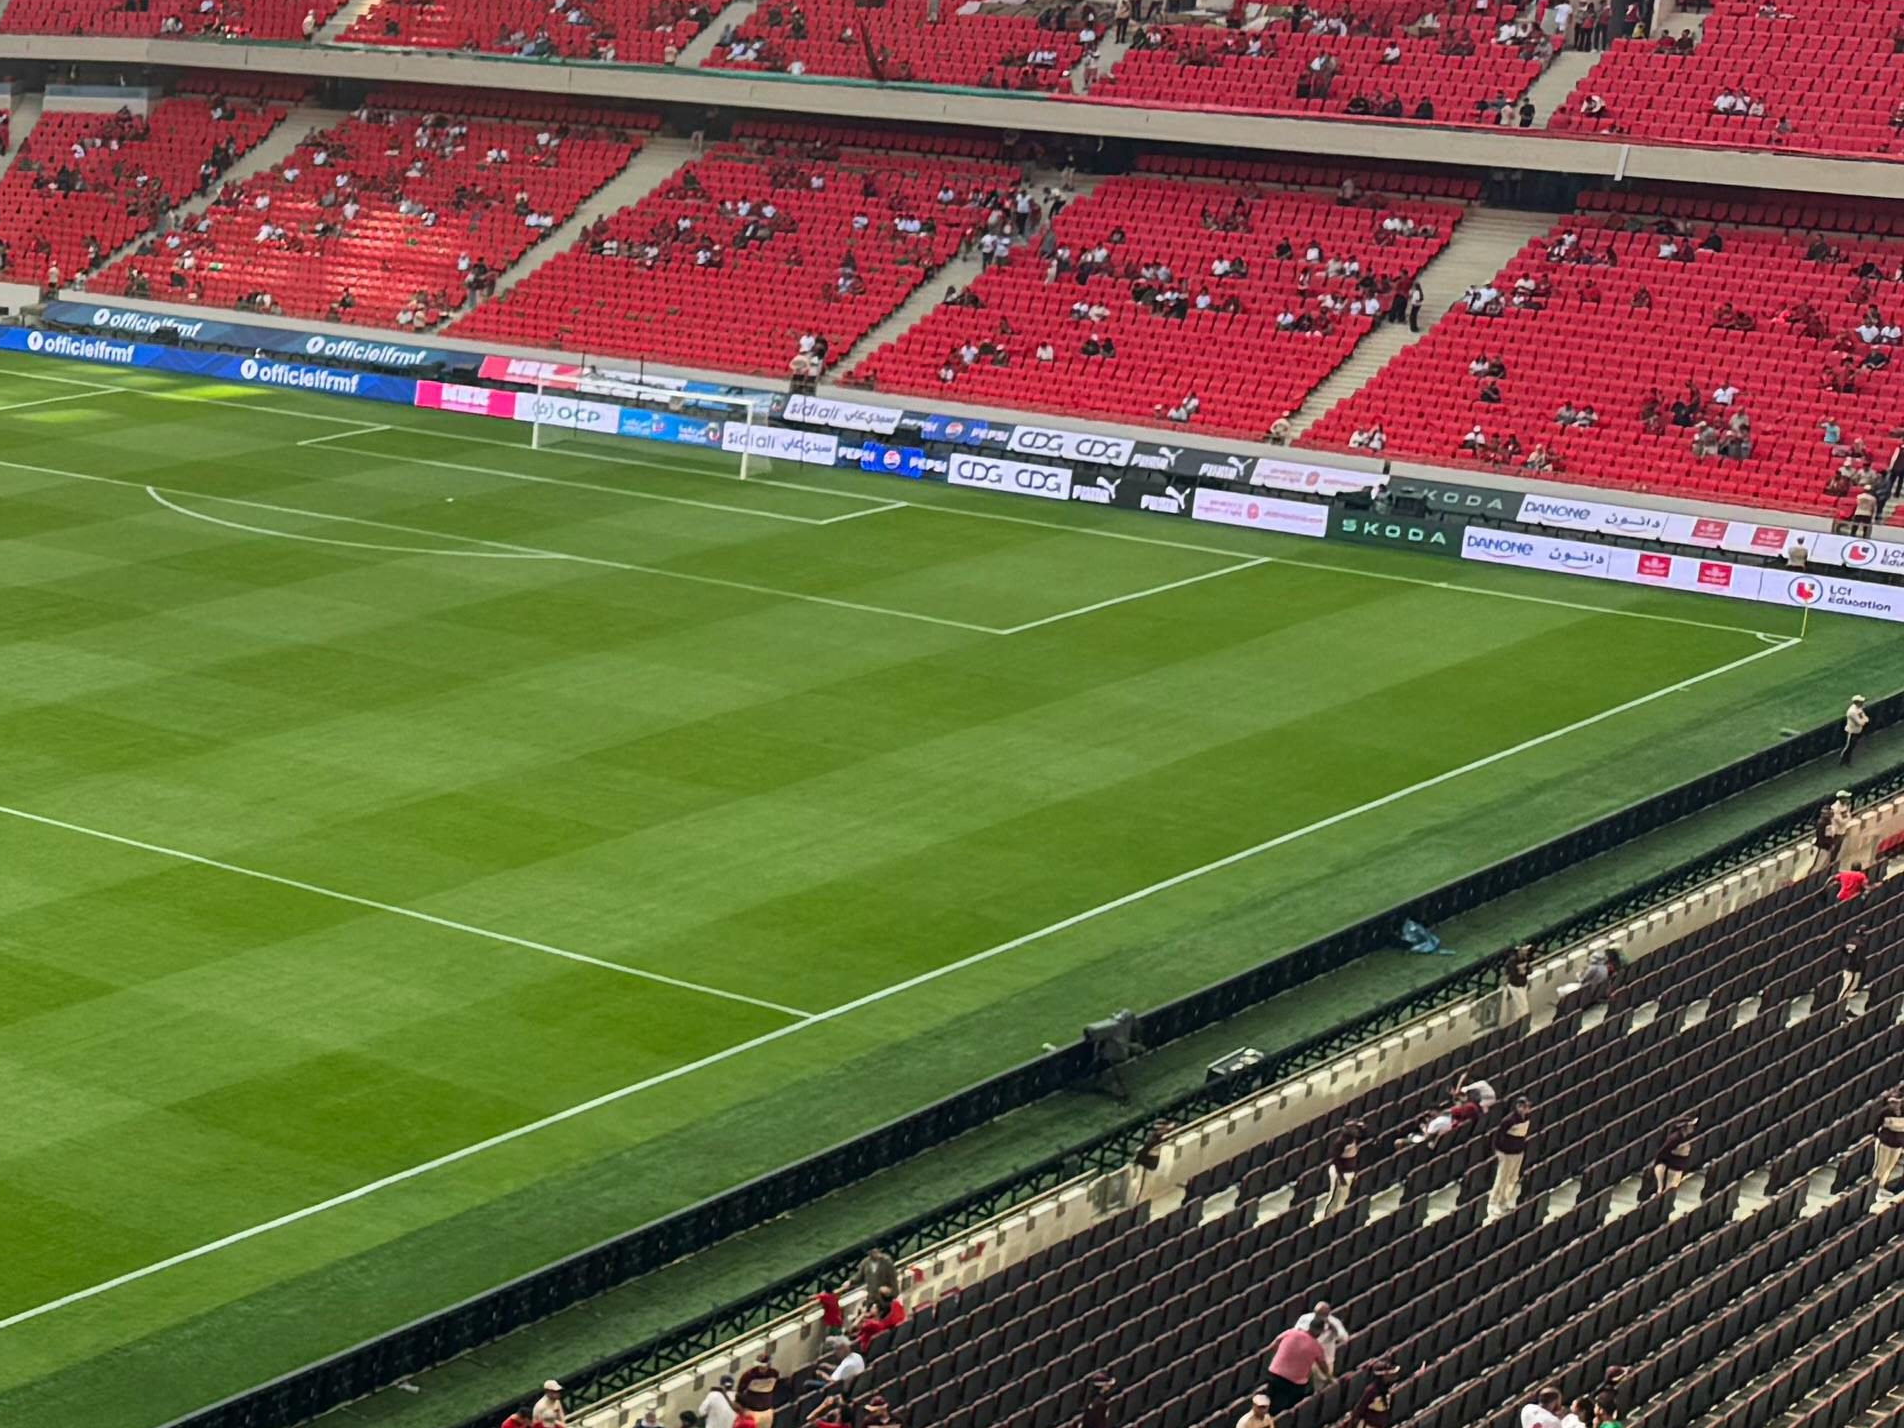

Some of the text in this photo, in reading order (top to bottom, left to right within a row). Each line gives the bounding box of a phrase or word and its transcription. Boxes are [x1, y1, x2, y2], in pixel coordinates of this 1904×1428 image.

[43, 335, 136, 363] officielfrmf
[259, 364, 360, 393] officielfrmf
[557, 407, 601, 422] OCP
[970, 425, 1010, 442] PEPSI
[1018, 430, 1123, 460] CDG CDG
[909, 456, 947, 472] PEPSI
[958, 460, 1062, 493] CDG CDG
[1404, 486, 1504, 510] KODA
[1467, 535, 1534, 556] DANONE
[1830, 585, 1852, 596] LCI
